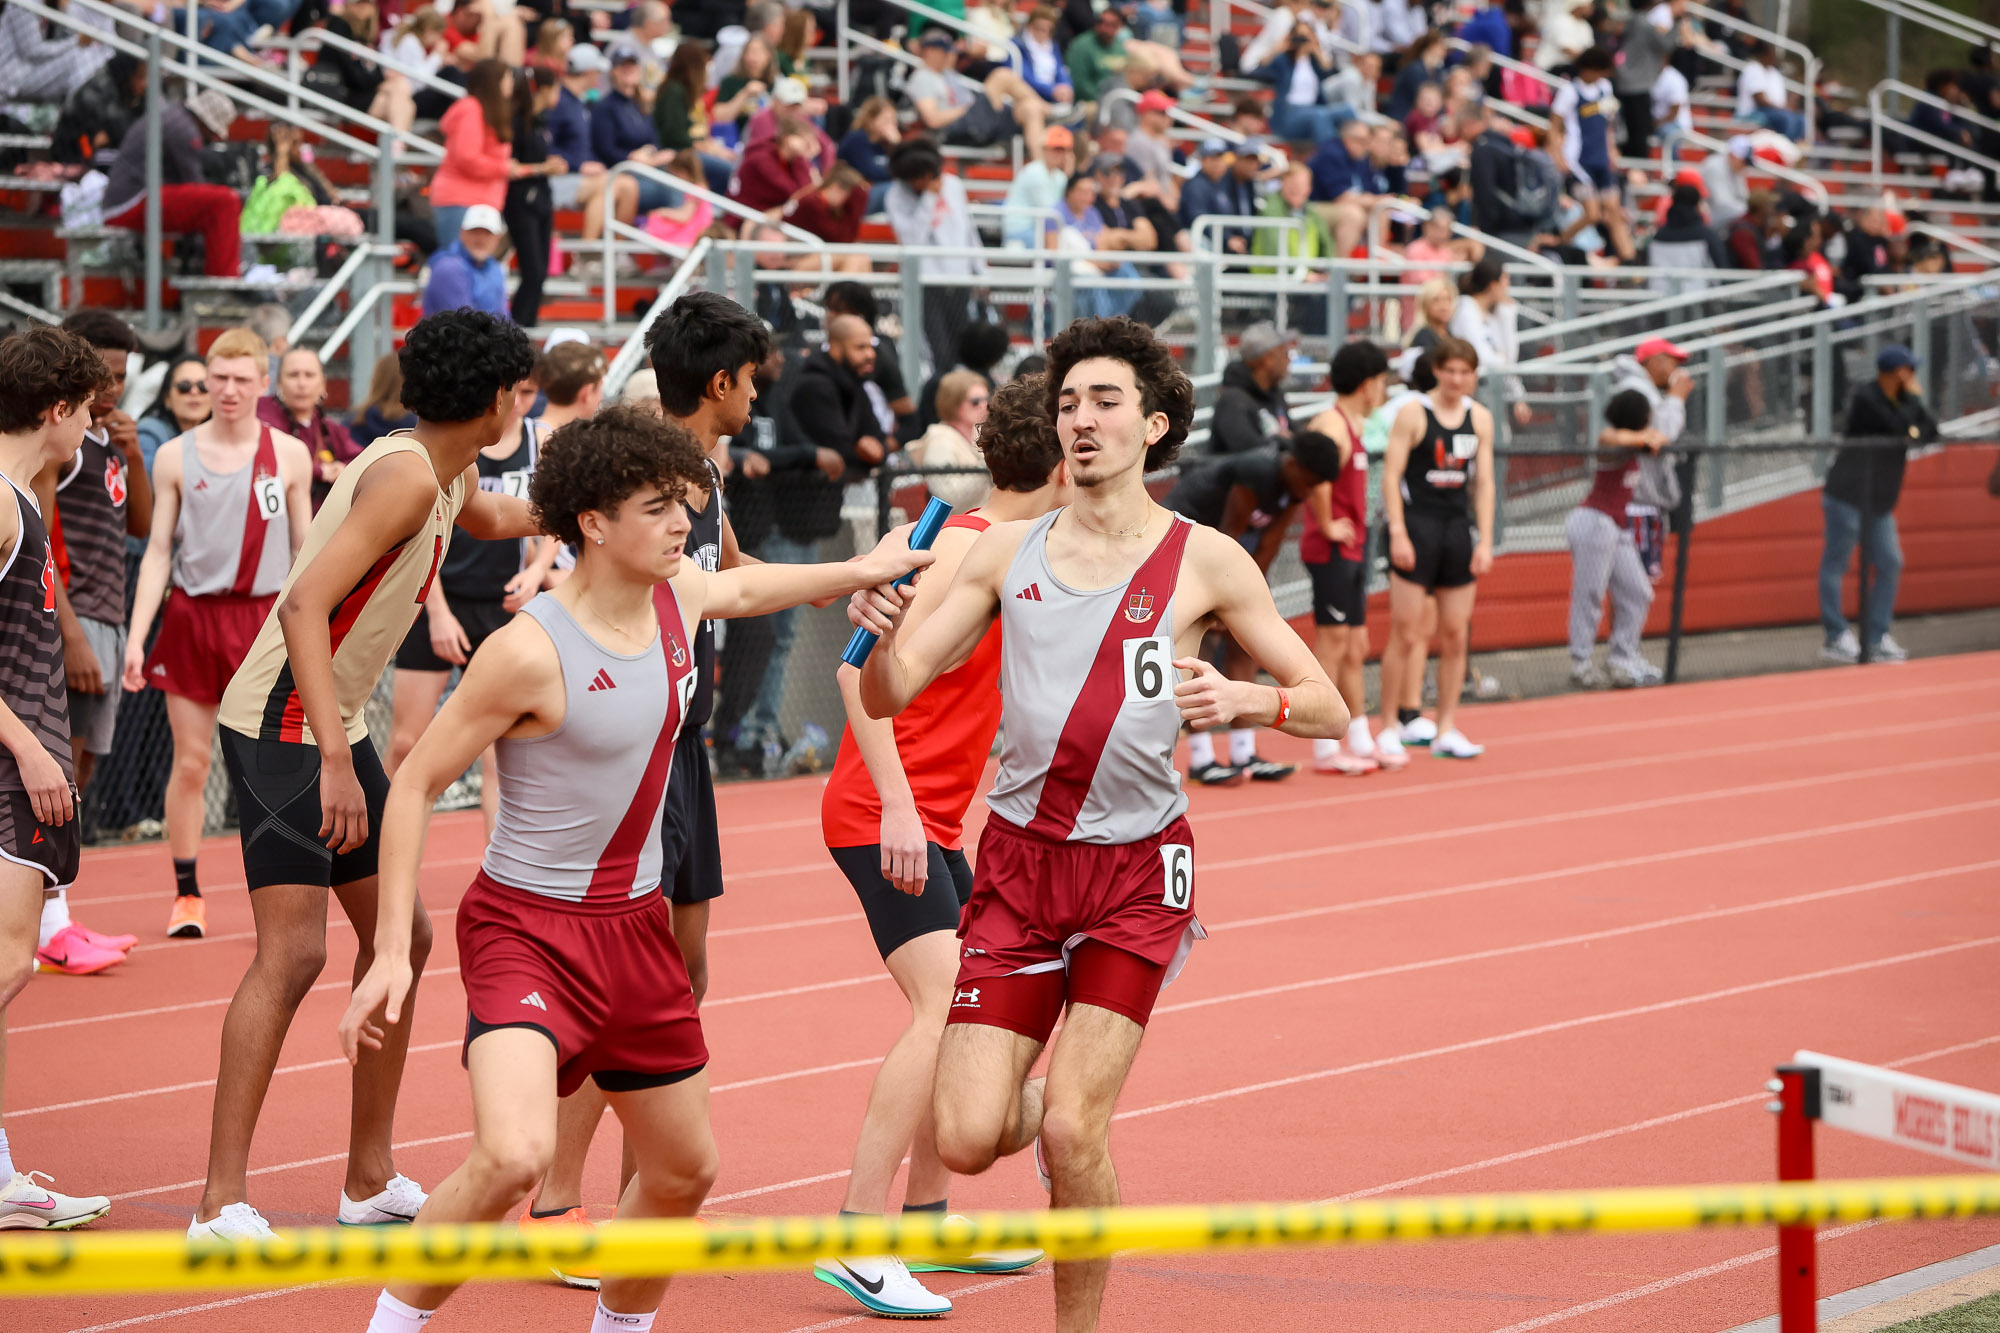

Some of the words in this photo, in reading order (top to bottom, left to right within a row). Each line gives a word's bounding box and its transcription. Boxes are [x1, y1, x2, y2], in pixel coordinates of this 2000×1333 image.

[264, 483, 279, 513] 6
[1134, 640, 1163, 698] 6
[1172, 848, 1187, 905] 6
